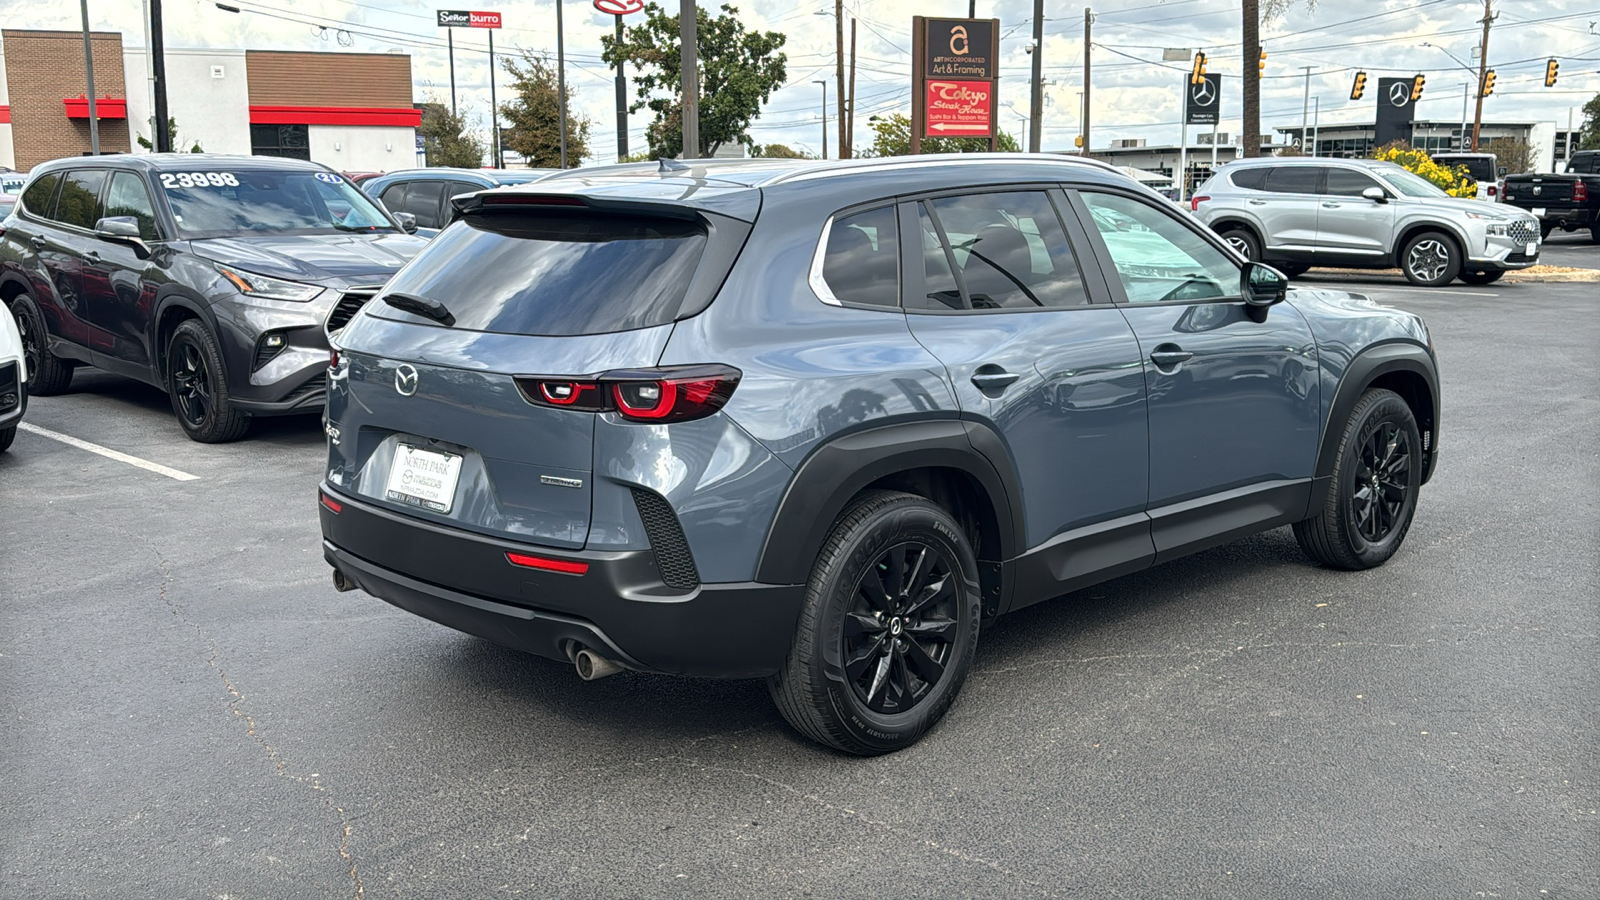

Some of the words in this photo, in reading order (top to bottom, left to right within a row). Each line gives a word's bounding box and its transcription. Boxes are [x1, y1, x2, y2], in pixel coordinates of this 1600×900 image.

[440, 11, 468, 22] Señor
[469, 13, 499, 23] burro
[933, 64, 946, 73] Art
[946, 64, 953, 73] &
[954, 64, 985, 76] Framing
[930, 83, 987, 106] Tokyo
[930, 100, 961, 109] Steak
[958, 105, 988, 114] House
[160, 173, 240, 189] 23998
[404, 456, 429, 471] NORTH
[429, 461, 450, 475] PARK
